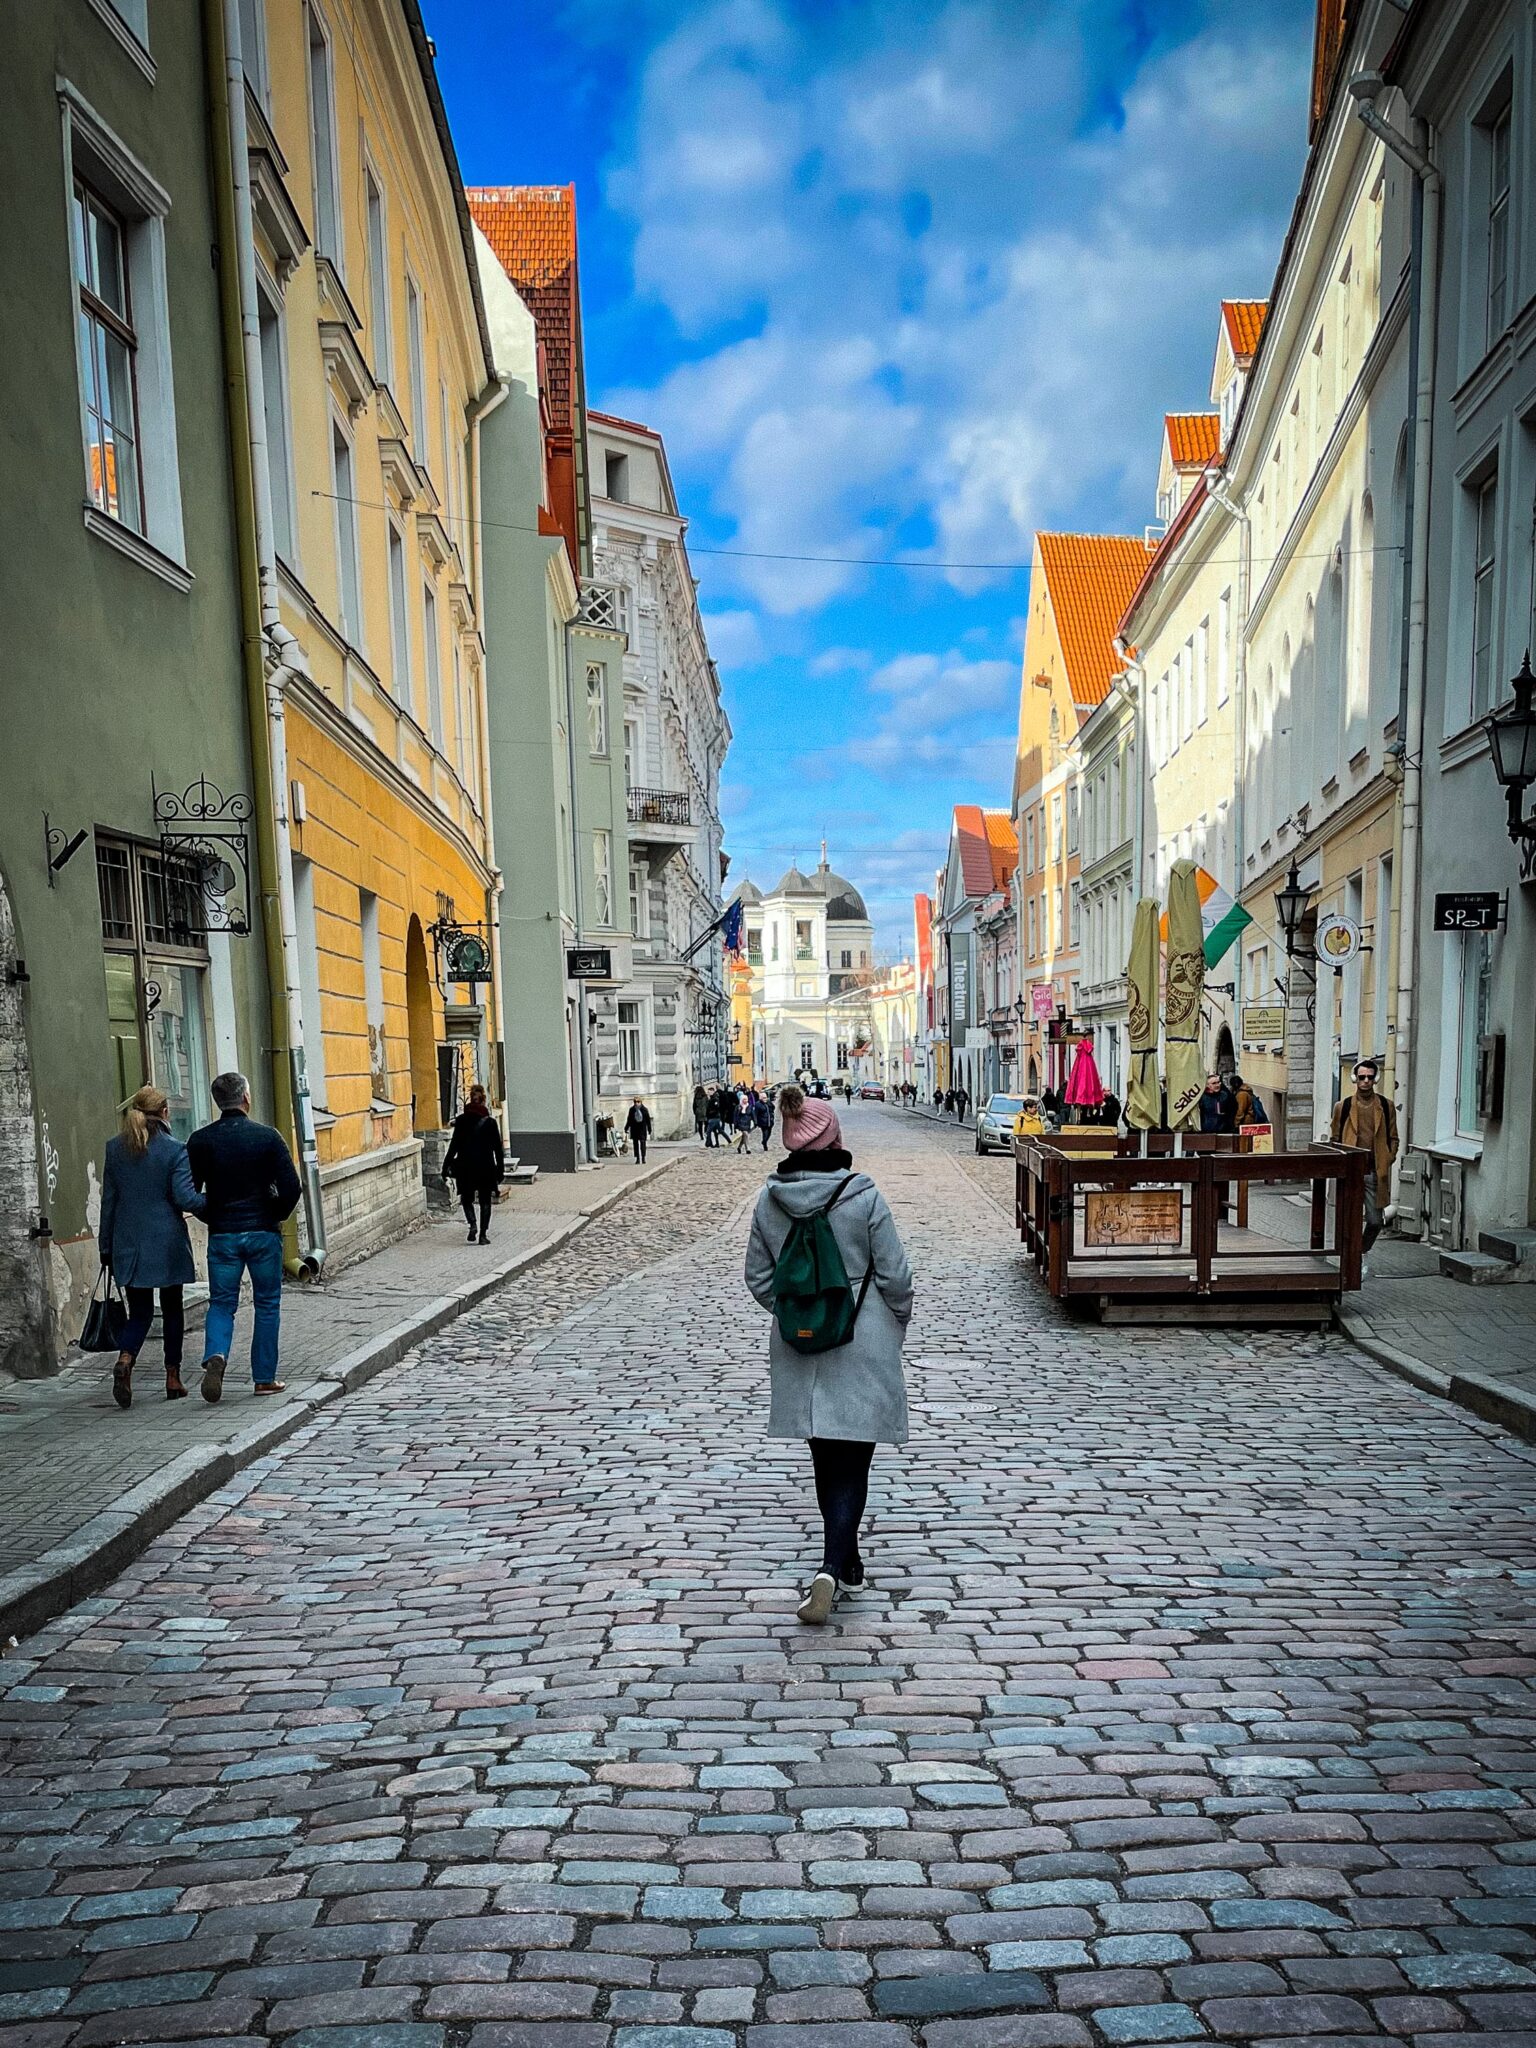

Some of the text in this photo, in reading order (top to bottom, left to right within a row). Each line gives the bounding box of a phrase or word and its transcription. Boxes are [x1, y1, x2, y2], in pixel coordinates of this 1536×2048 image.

[1444, 908, 1491, 927] SPOT
[954, 960, 967, 1020] Theatrum
[1033, 990, 1052, 1000] Gild
[1174, 1083, 1201, 1113] saku
